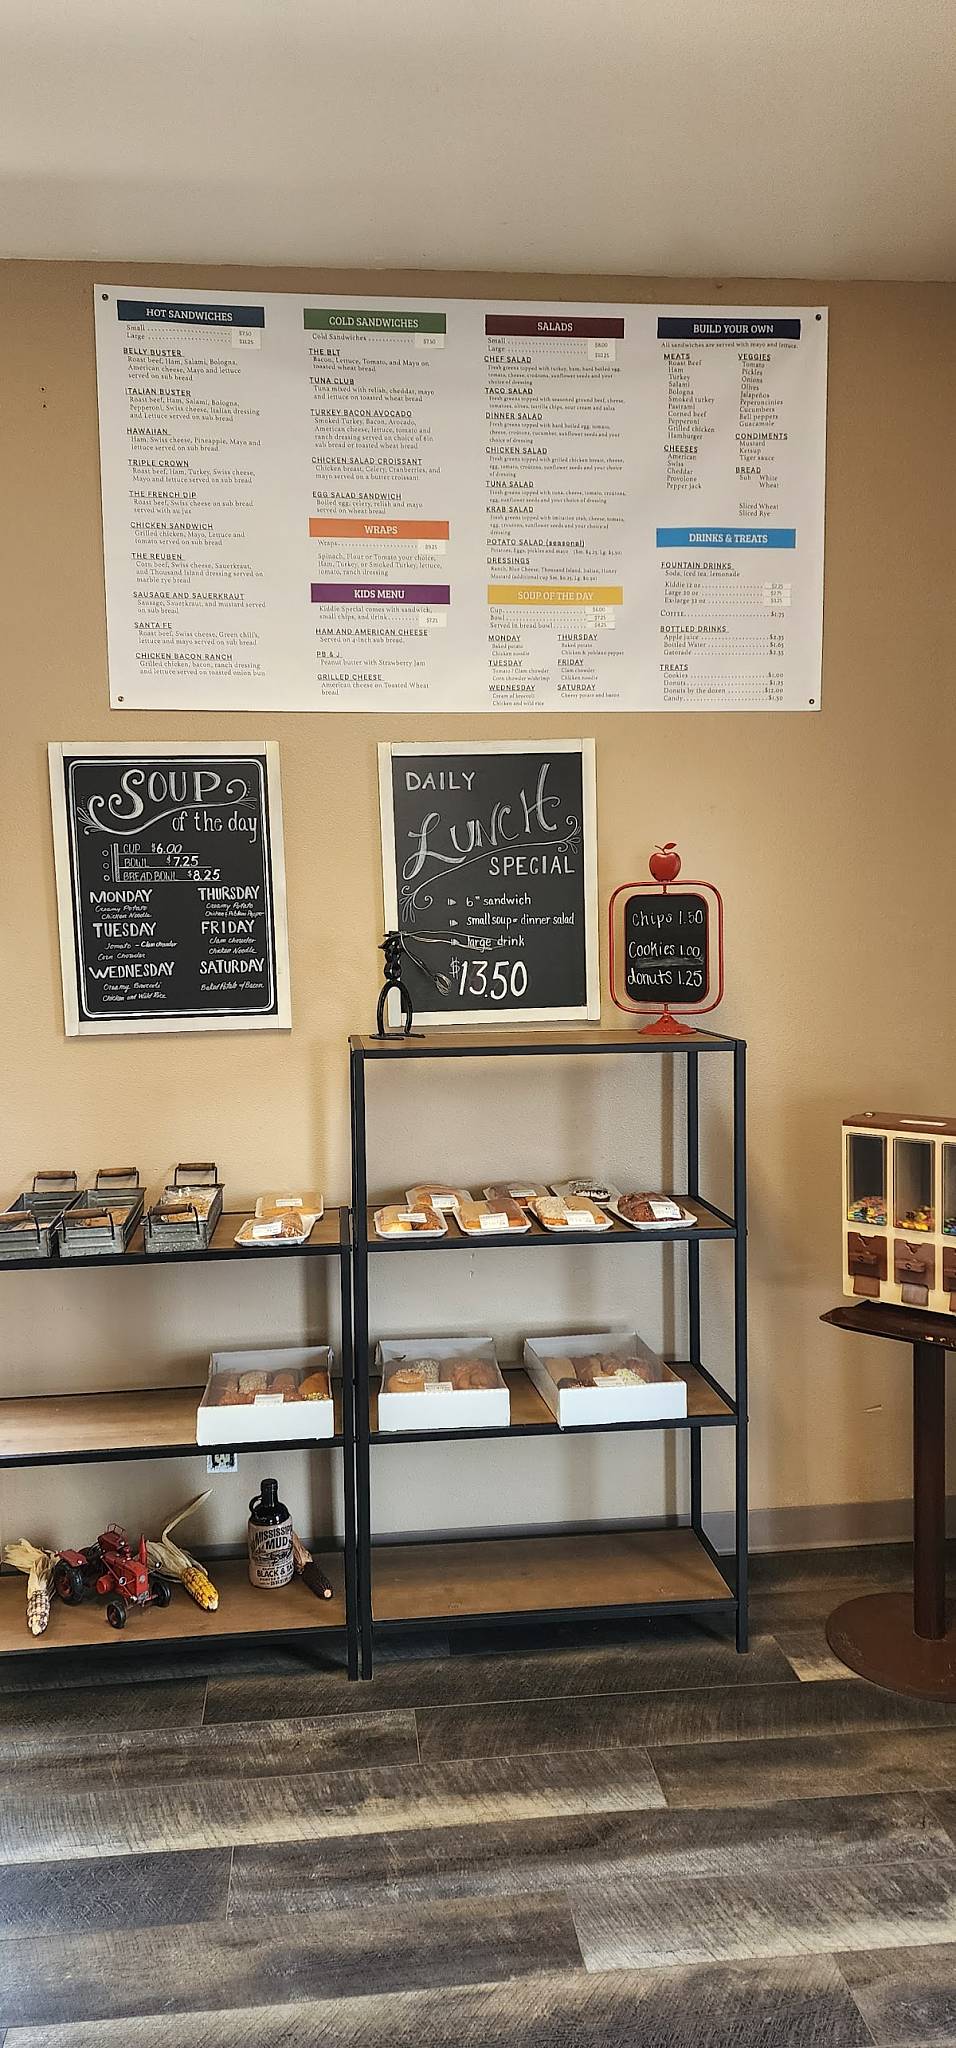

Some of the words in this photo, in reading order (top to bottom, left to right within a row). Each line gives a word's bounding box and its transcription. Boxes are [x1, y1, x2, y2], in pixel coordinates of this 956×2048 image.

[145, 308, 167, 317] HOT
[168, 309, 233, 321] SANDWICHES
[329, 317, 354, 326] COLD
[356, 318, 419, 328] SANDWICHES
[537, 322, 573, 332] SALADS
[694, 324, 721, 334] BUILD
[723, 325, 749, 334] YOUR
[751, 325, 774, 333] OWN
[123, 347, 147, 355] BELLY
[150, 349, 182, 357] BUSTER
[308, 348, 325, 356] THE
[159, 388, 191, 396] BUSTER
[664, 445, 698, 453] CHEESES
[349, 457, 375, 465] SALAD
[169, 522, 213, 530] SANDWICH
[364, 525, 398, 534] WRAPS
[689, 534, 724, 543] DRINKS
[725, 534, 732, 543] &
[734, 534, 768, 543] TREATS
[133, 591, 170, 599] SAUSAGE
[192, 592, 244, 600] SAUERKRAUT
[354, 589, 375, 598] KIDS
[377, 590, 405, 599] MENU
[518, 591, 542, 600] SOUP
[544, 592, 555, 600] OF
[557, 592, 575, 600] THE
[576, 592, 594, 600] DAY
[136, 652, 171, 660] CHICKEN
[204, 653, 232, 661] RANCH
[406, 772, 476, 790] DAILY
[109, 769, 222, 820] SOUP
[172, 812, 189, 832] of
[194, 812, 223, 832] the
[228, 811, 258, 843] day
[403, 763, 560, 880] LUNCH
[123, 844, 140, 853] CUP
[152, 843, 182, 854] $6.00
[124, 858, 149, 868] BOWL
[166, 856, 199, 867] $7.25
[489, 856, 575, 876] SPECIAL
[123, 872, 152, 881] BREAD
[154, 871, 177, 881] BOWL
[187, 869, 221, 881] $8.25
[90, 889, 152, 903] MONDAY
[198, 886, 260, 901] THURSDAY
[483, 893, 531, 905] sandwich
[466, 913, 490, 925] small
[492, 916, 512, 929] soup
[521, 914, 550, 925] dinner
[553, 912, 575, 925] salad
[679, 910, 703, 925] 1.50
[93, 922, 156, 938] TUESDAY
[201, 920, 255, 934] FRIDAY
[468, 935, 491, 953] large
[497, 935, 525, 946] drink
[629, 942, 675, 959] Cookies
[680, 944, 701, 957] 1.00
[89, 962, 175, 979] WEDNESDAY
[200, 958, 264, 974] SATURDAY
[450, 957, 527, 999] $13.50
[628, 968, 672, 985] donuts
[678, 970, 702, 987] 1.25
[266, 1537, 287, 1549] MUD
[257, 1569, 278, 1577] BLACK
